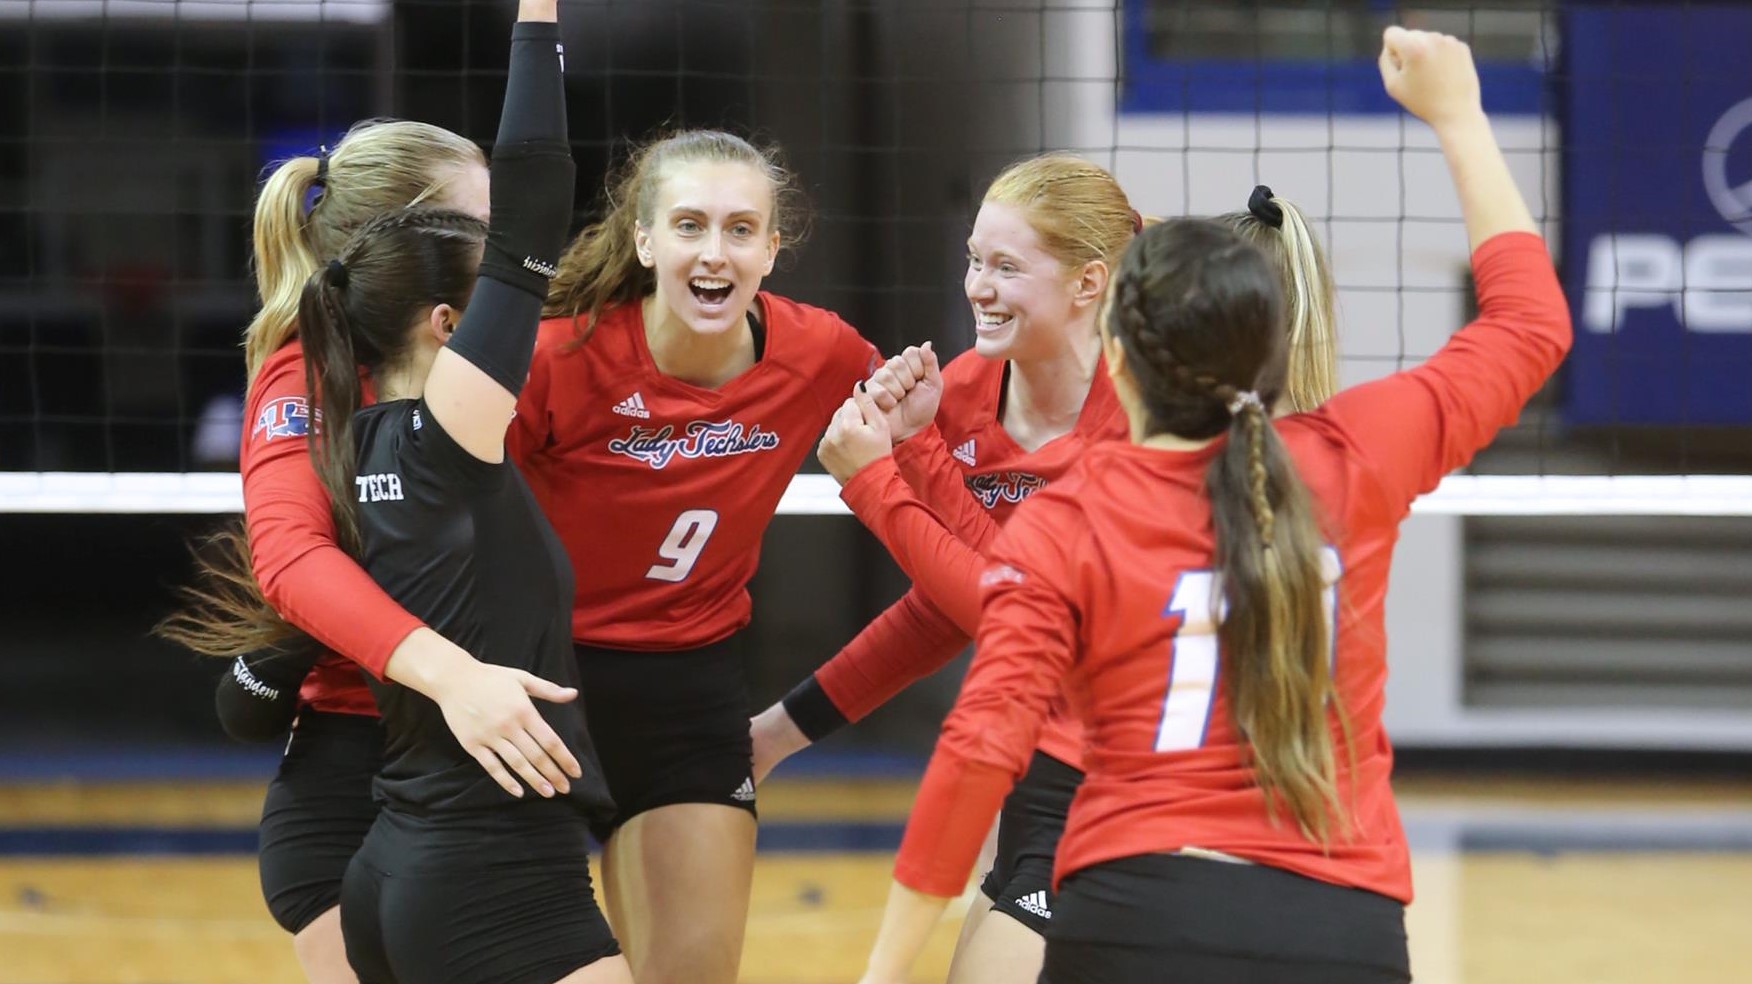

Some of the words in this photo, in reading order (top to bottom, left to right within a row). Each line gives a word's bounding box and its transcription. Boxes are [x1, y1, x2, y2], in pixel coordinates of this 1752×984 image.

[612, 405, 650, 419] adidas
[608, 426, 678, 469] Lady
[675, 419, 780, 458] Techsters
[355, 473, 404, 502] TECH
[644, 509, 719, 583] 9
[1015, 898, 1052, 919] adidas
